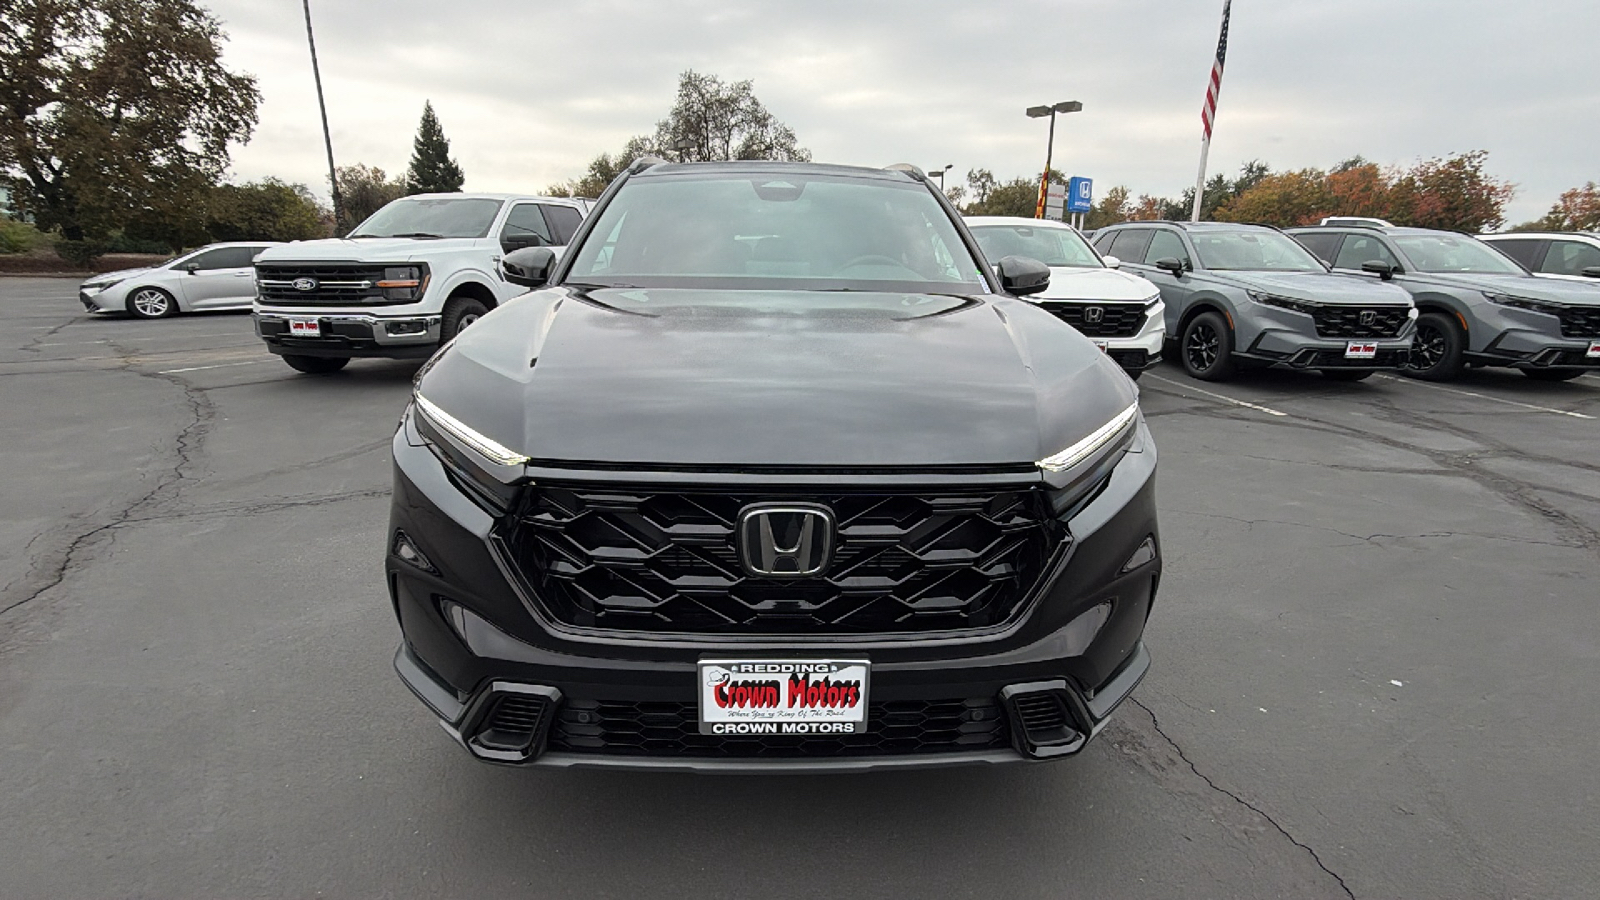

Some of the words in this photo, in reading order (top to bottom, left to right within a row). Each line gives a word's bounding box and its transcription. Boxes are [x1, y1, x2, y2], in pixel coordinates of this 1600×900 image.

[740, 664, 829, 673] REDDING
[713, 673, 781, 709] Crown
[787, 674, 860, 709] Motors
[727, 710, 750, 718] Where
[777, 710, 795, 718] King
[798, 710, 807, 718] Of
[713, 723, 777, 733] CROWN
[782, 723, 855, 733] MOTORS
